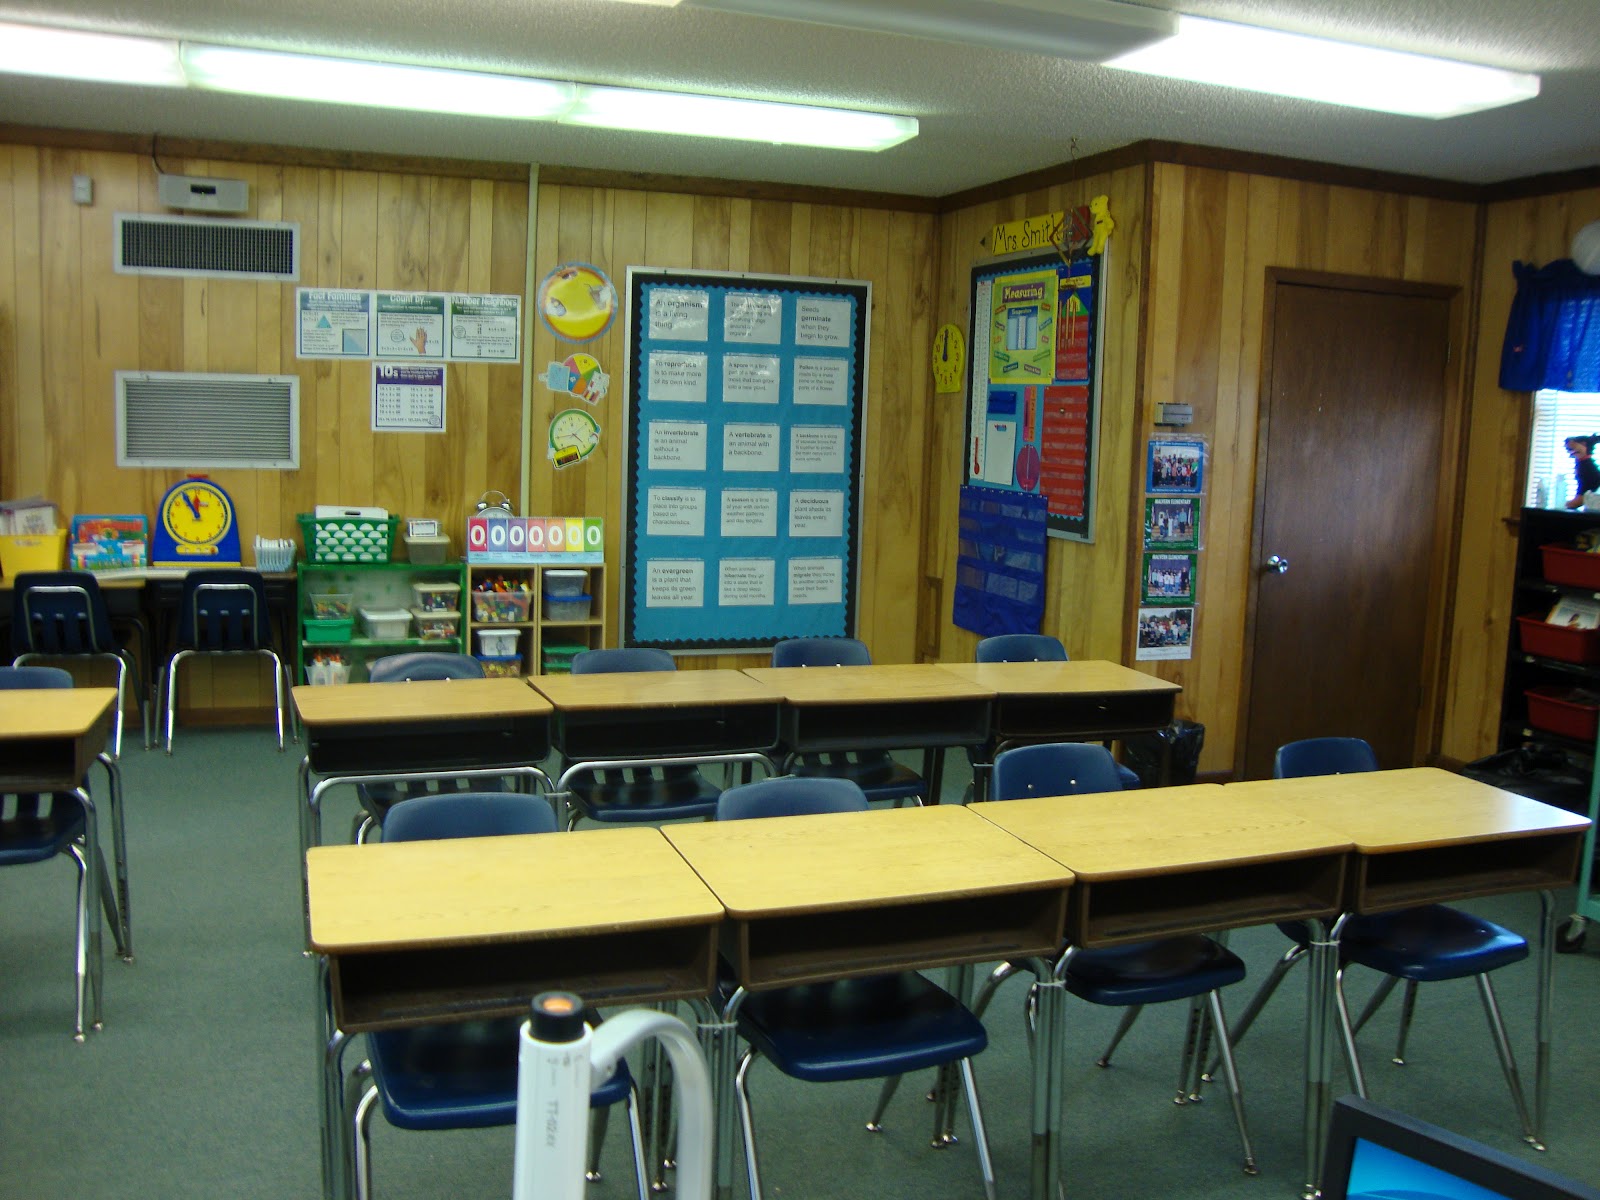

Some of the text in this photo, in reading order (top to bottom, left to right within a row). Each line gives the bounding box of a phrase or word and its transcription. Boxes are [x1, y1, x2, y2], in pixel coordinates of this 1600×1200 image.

[993, 213, 1060, 253] Mrs. Smith
[328, 291, 362, 302] Families
[1005, 284, 1043, 300] Measuring
[390, 295, 413, 304] Count
[451, 296, 517, 307] Number Neighbors
[667, 300, 703, 309] organism
[801, 305, 820, 313] Seeds
[669, 310, 688, 320] living
[664, 361, 697, 369] reproduce
[379, 364, 399, 379] 10s
[661, 495, 684, 503] classify
[652, 585, 670, 593] keeps
